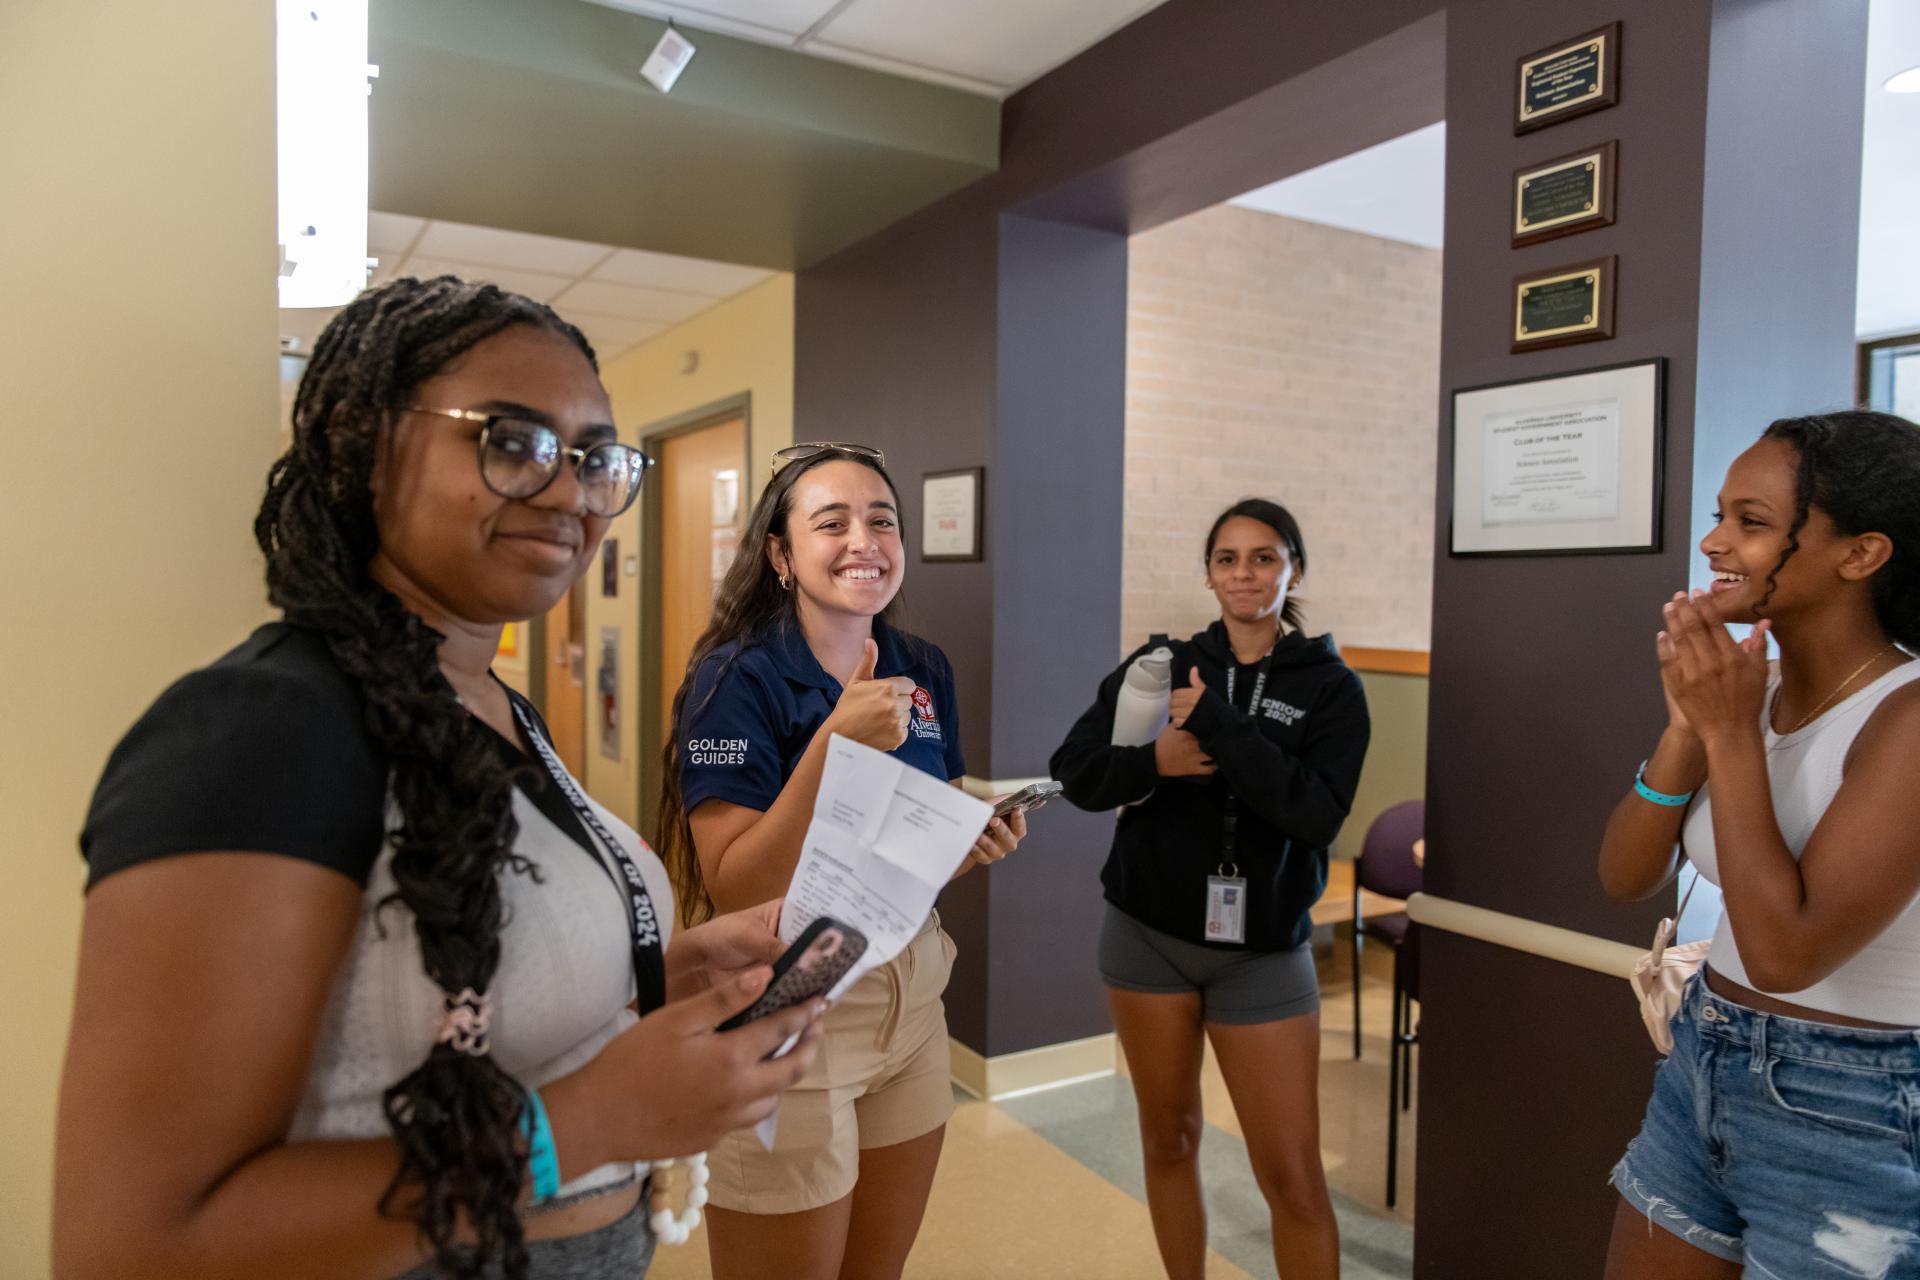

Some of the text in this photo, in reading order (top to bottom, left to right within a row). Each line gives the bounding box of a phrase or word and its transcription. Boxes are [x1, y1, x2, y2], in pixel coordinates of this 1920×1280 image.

[1264, 708, 1293, 727] 2024
[688, 738, 748, 752] GOLDEN
[691, 752, 745, 765] GUIDES
[582, 810, 627, 859] CLASS
[622, 862, 644, 888] OF
[633, 894, 659, 947] 2024
